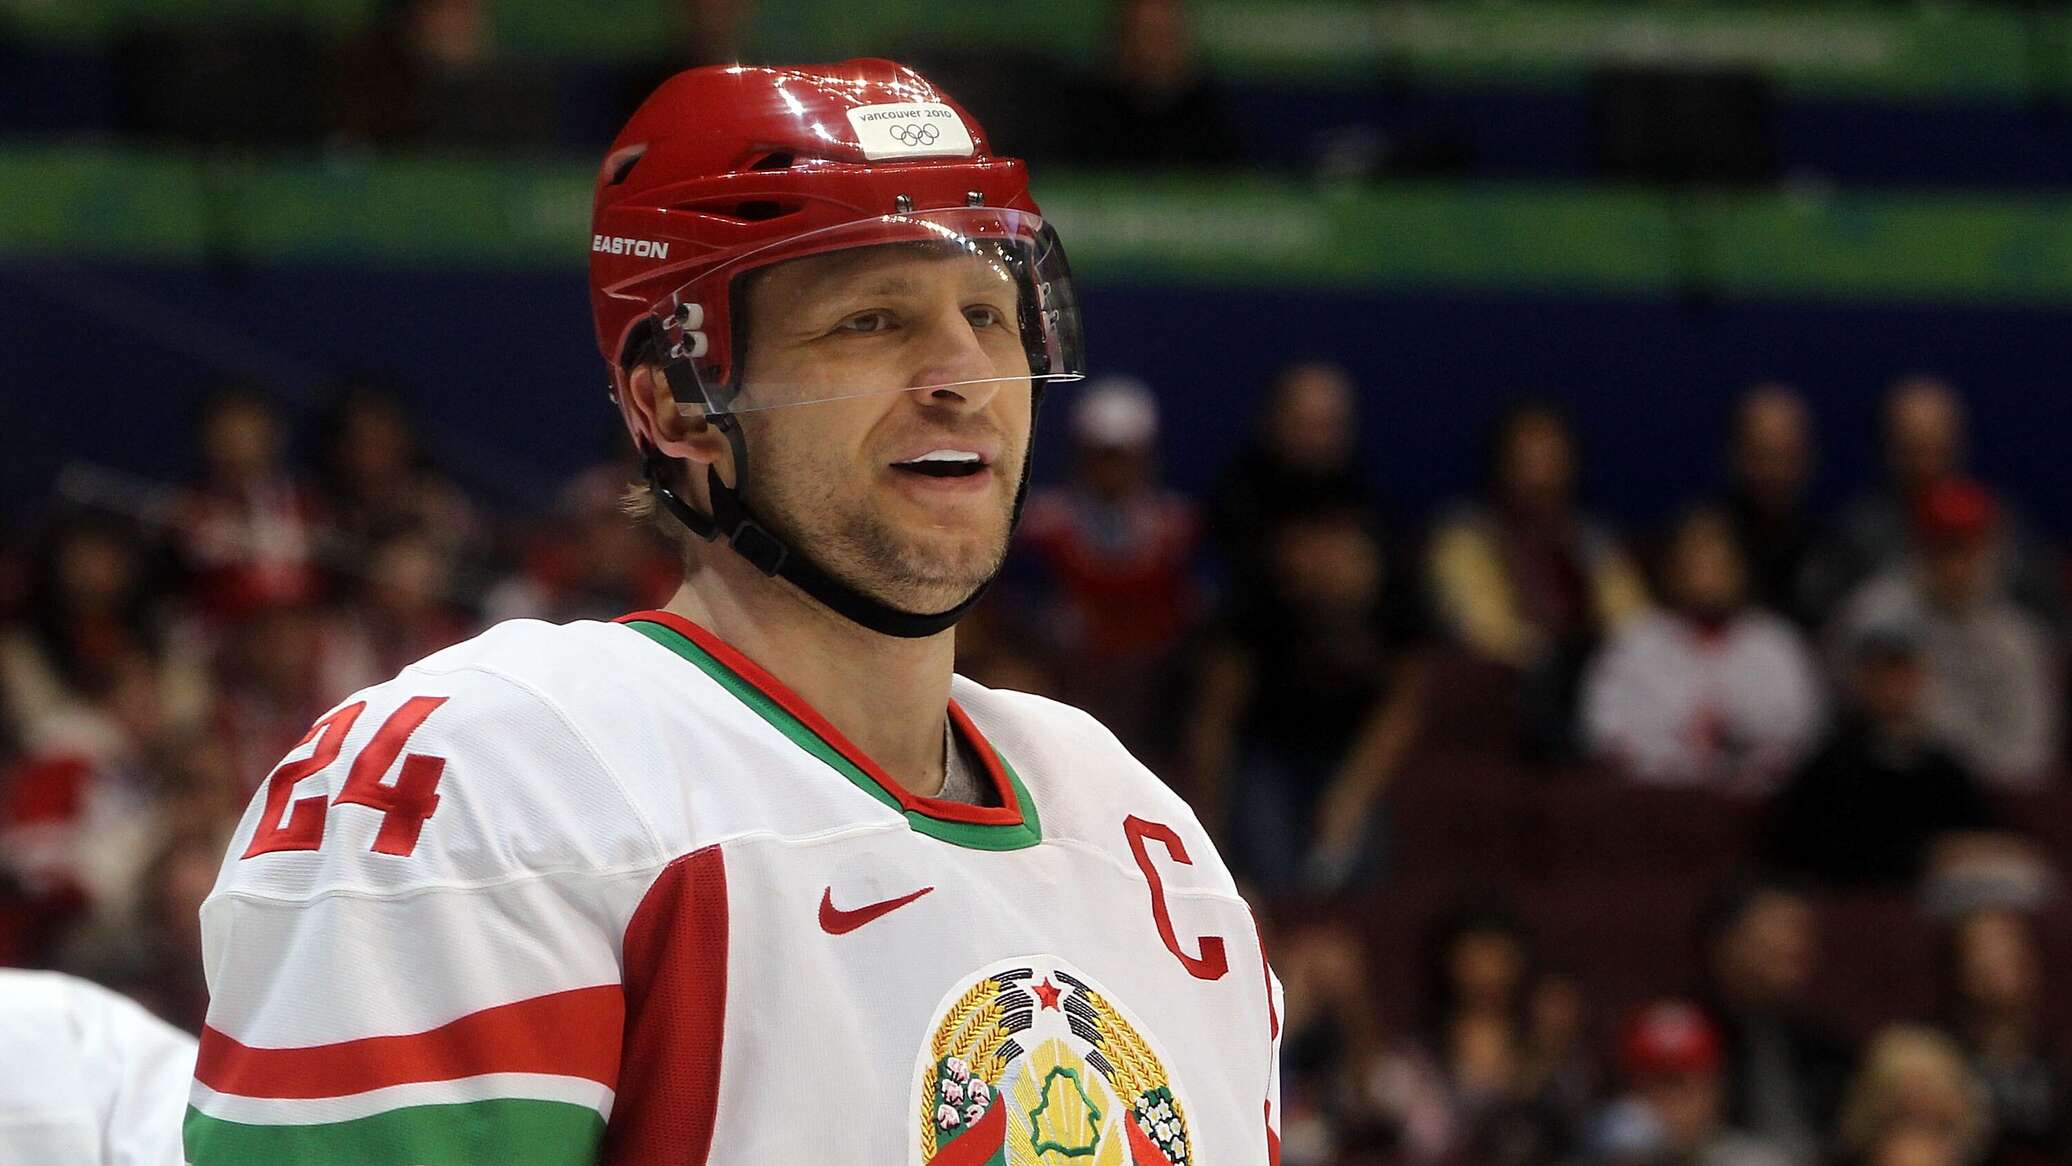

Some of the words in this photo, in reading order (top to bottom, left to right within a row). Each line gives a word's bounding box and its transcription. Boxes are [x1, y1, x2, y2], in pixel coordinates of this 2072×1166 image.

[859, 109, 921, 122] vancouver
[925, 109, 952, 119] 2010
[592, 235, 669, 259] EASTON
[240, 696, 449, 860] 24
[1123, 814, 1229, 981] C
